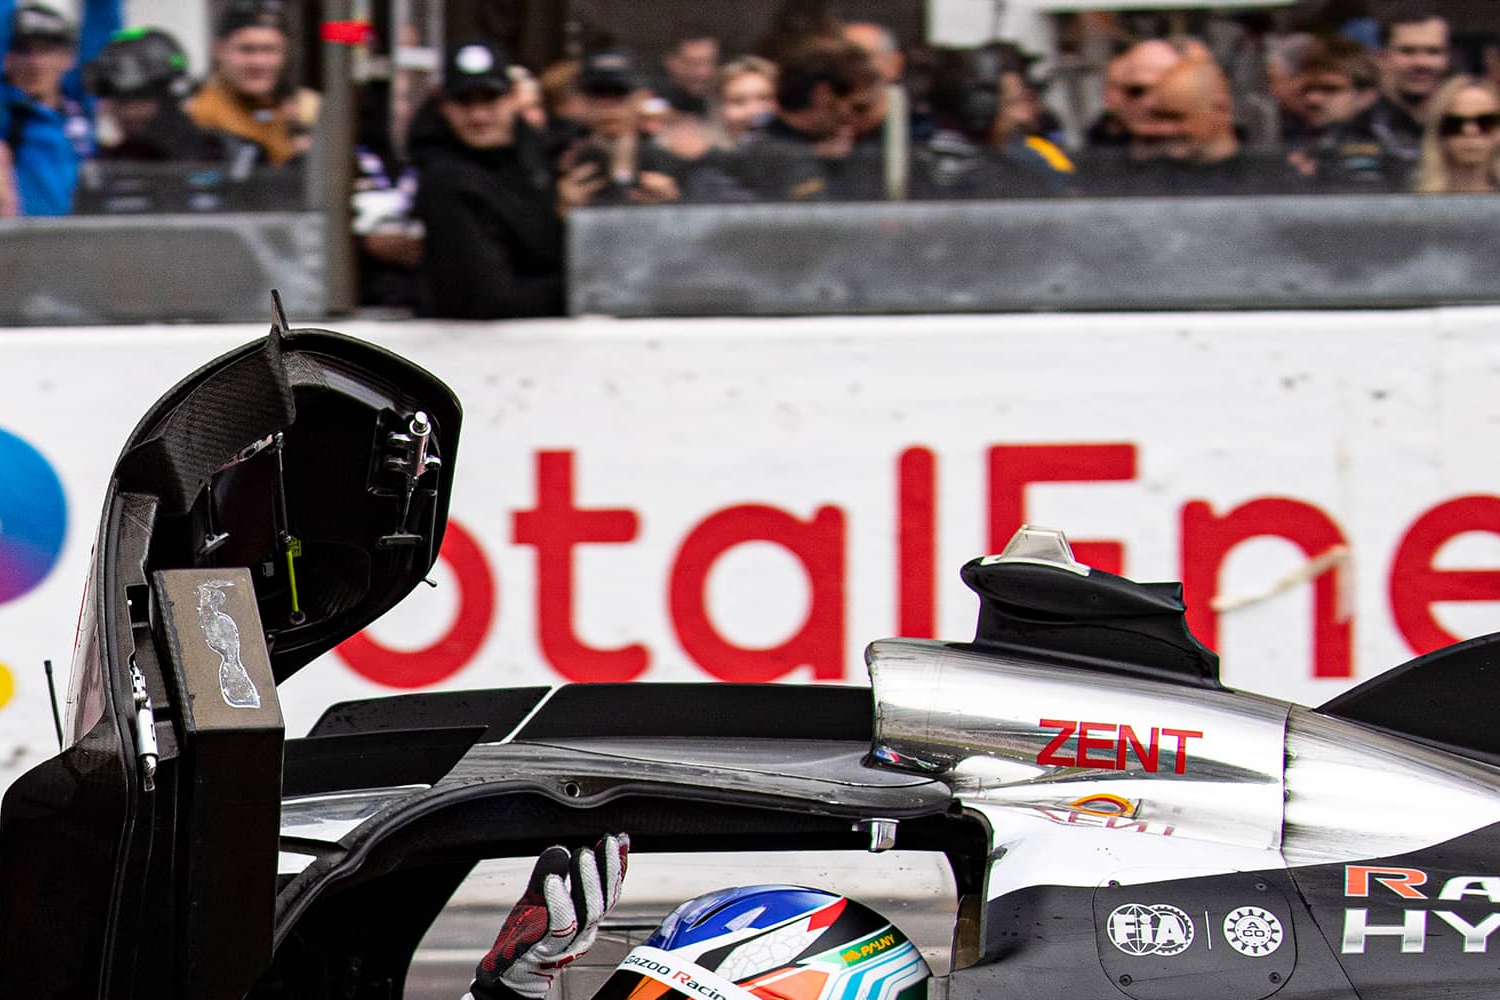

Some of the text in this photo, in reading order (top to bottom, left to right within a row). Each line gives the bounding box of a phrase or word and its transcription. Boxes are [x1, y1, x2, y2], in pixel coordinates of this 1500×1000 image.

[332, 442, 1500, 690] otalEne
[1037, 718, 1204, 775] ZENT
[624, 955, 671, 975] GAZOO
